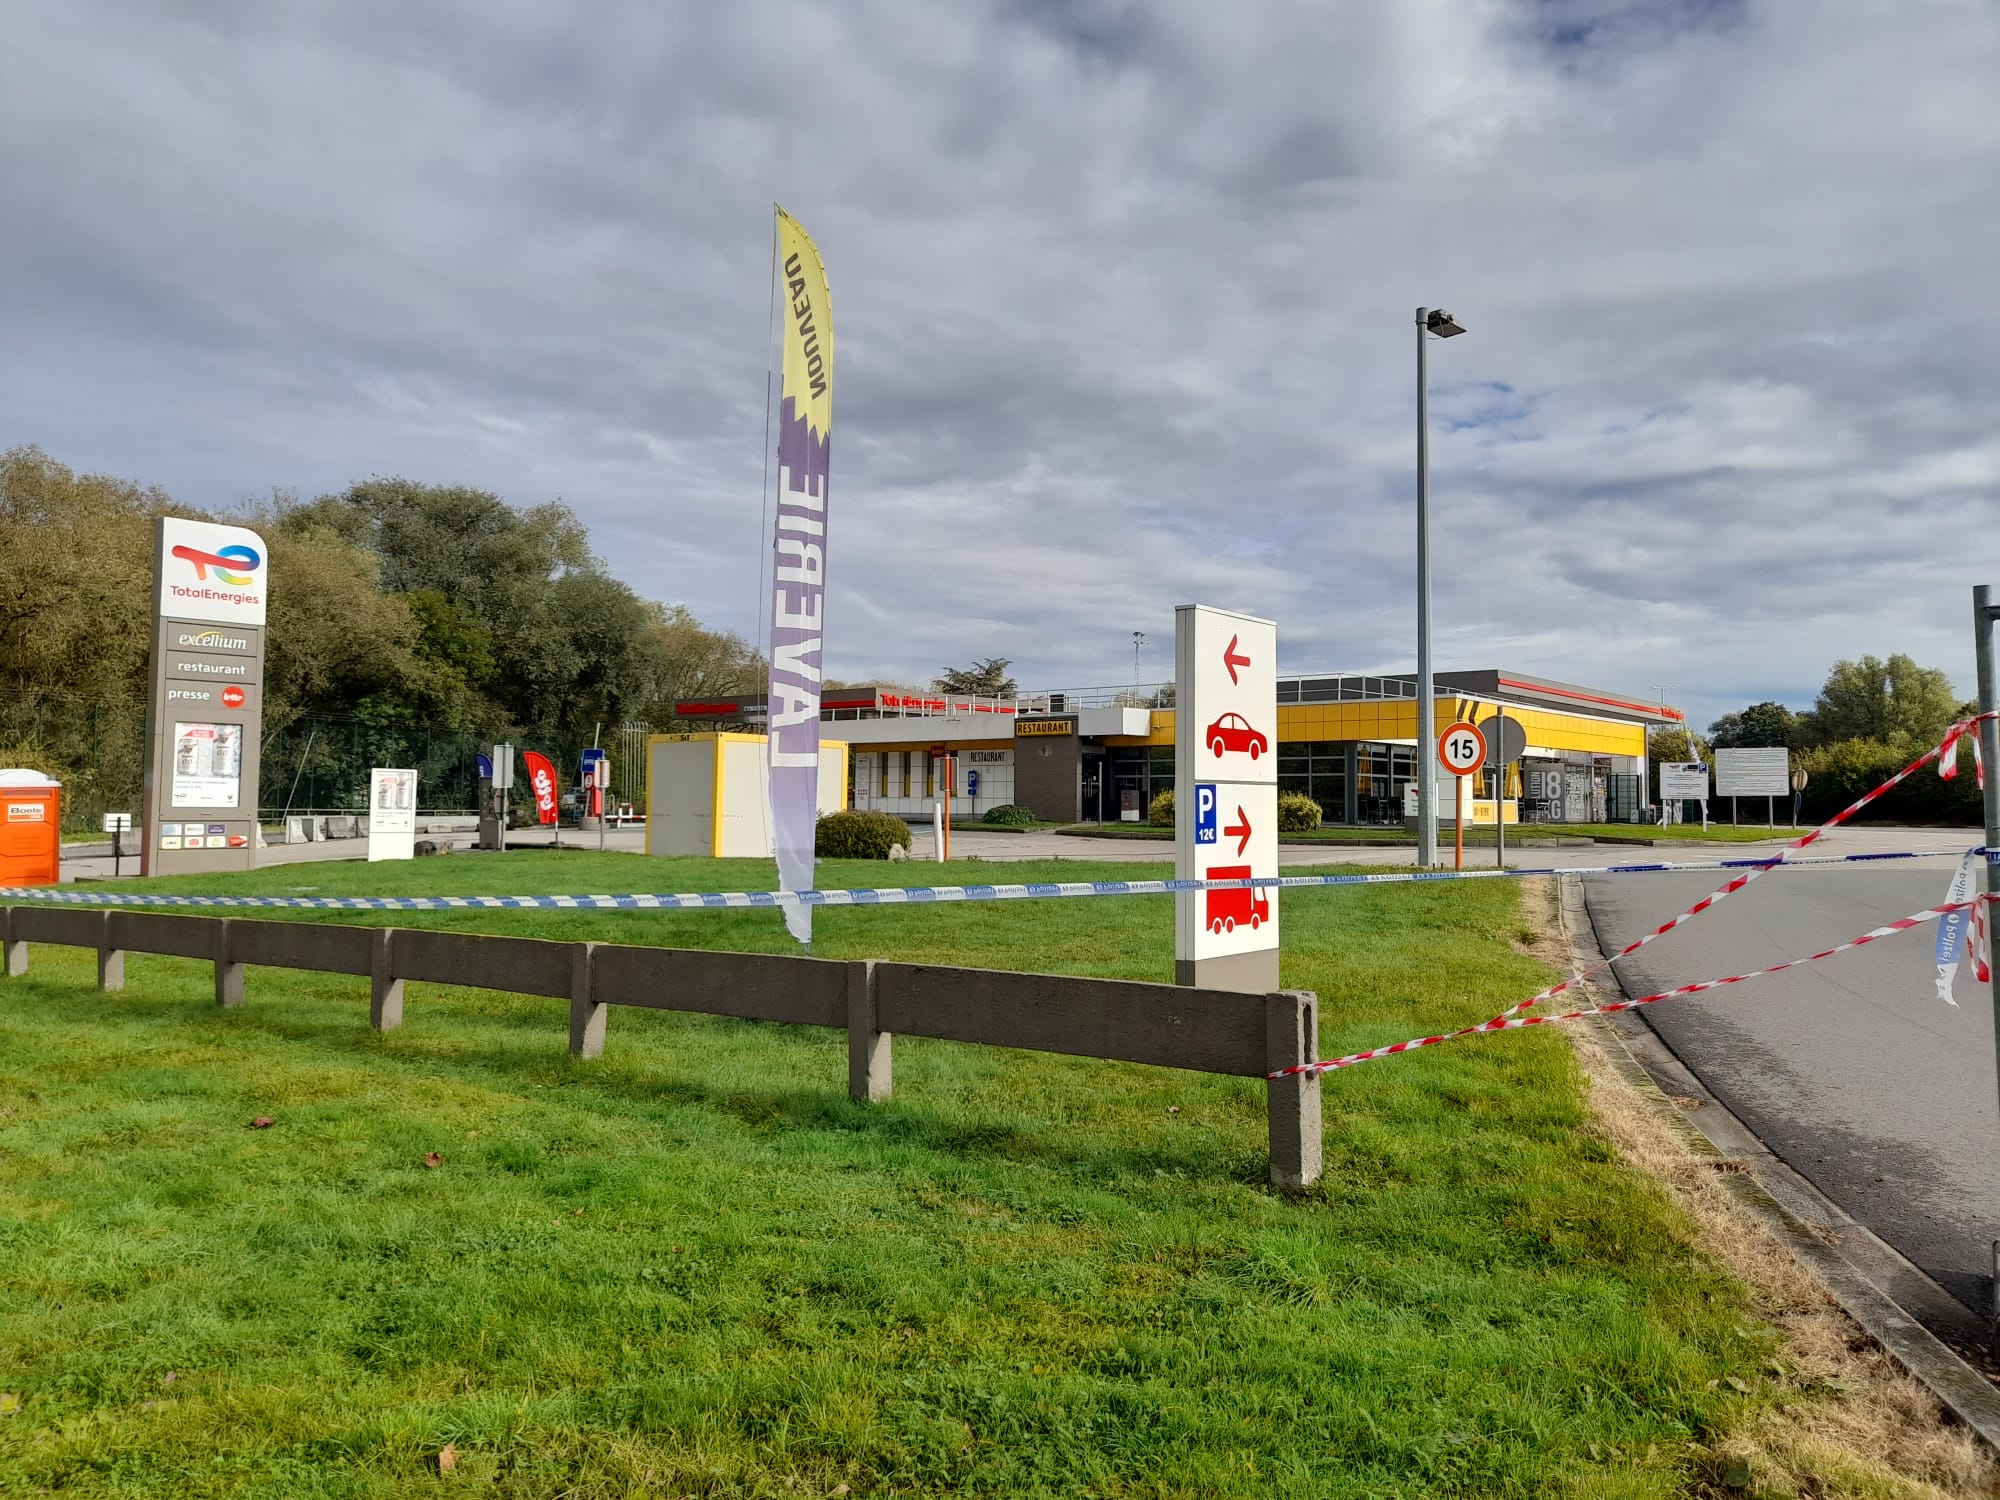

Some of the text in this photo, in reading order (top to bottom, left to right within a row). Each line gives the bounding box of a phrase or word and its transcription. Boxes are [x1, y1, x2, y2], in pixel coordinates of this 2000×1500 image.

[170, 586, 259, 604] TotalEnergies
[178, 633, 247, 650] excellium
[178, 662, 246, 675] restaurant
[168, 689, 211, 701] presse
[1017, 721, 1069, 734] RESTAURANT
[1449, 739, 1474, 759] 15
[970, 751, 1005, 762] RESTAURANT
[969, 772, 976, 785] P
[1198, 788, 1213, 824] P
[1199, 828, 1214, 841] 12€
